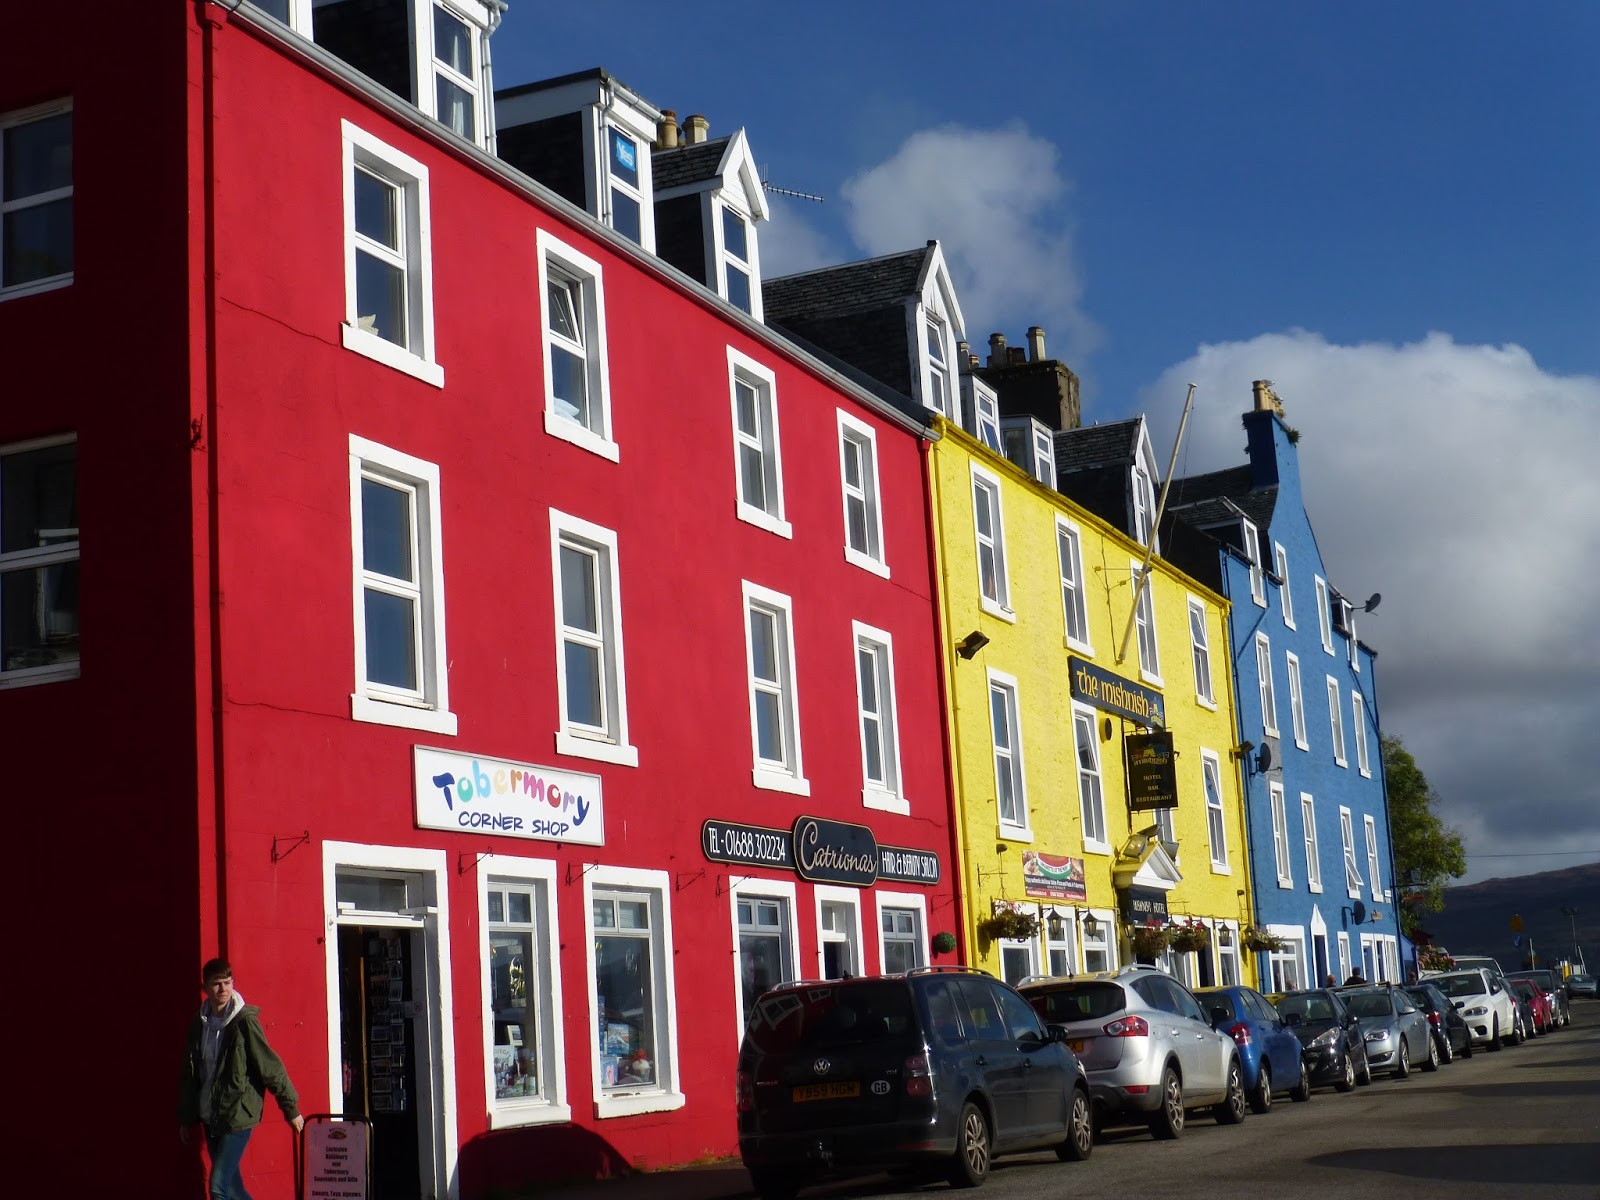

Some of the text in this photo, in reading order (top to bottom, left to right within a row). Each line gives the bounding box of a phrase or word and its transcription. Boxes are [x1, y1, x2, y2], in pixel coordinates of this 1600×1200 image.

[1076, 666, 1149, 719] the mishnish
[432, 759, 590, 826] Tobermory
[458, 811, 570, 836] CORNER SHOP
[755, 834, 786, 862] 302234
[881, 851, 896, 874] HAIR
[902, 854, 921, 876] BEAUTY
[921, 856, 938, 878] SALON
[1153, 902, 1166, 914] HOTEL
[874, 1082, 887, 1093] GB
